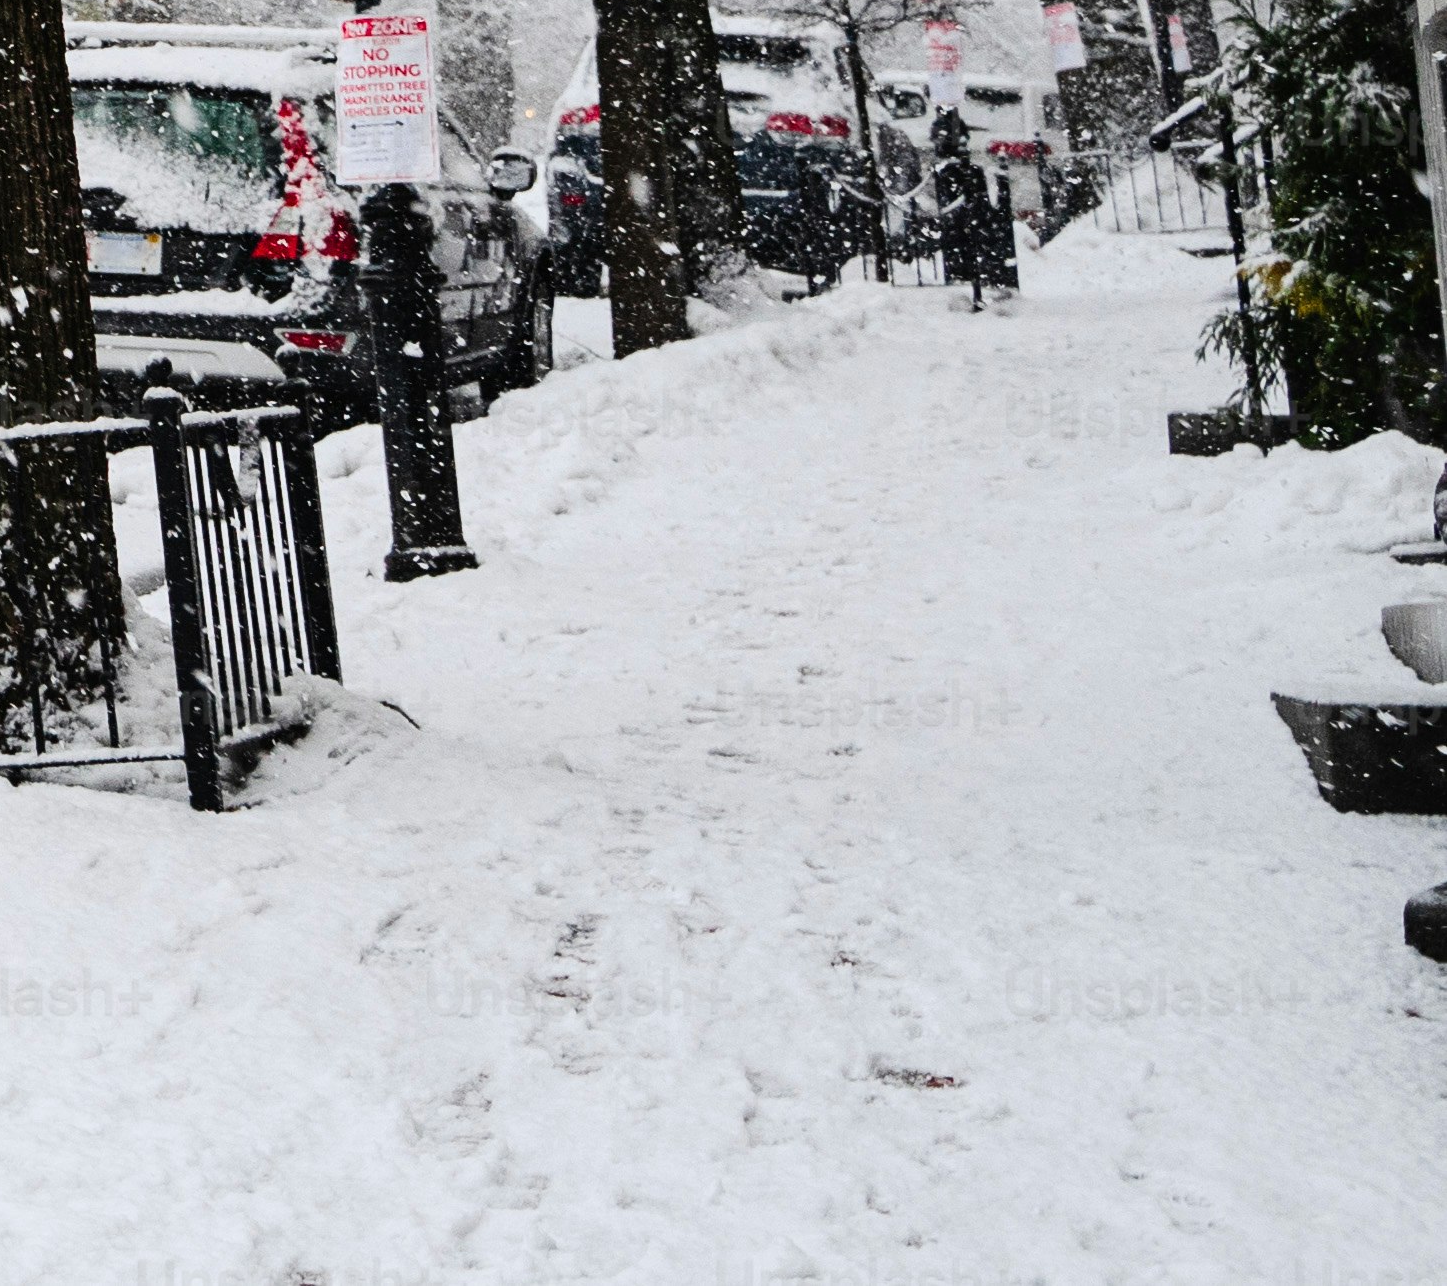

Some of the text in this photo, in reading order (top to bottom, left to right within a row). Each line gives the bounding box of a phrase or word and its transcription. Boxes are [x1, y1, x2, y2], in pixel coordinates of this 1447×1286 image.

[363, 48, 389, 61] NO
[343, 64, 421, 79] STOPPING
[398, 80, 426, 90] TREE
[344, 93, 423, 105] MAINTENANCE
[344, 105, 425, 117] VEHICLES ONLY
